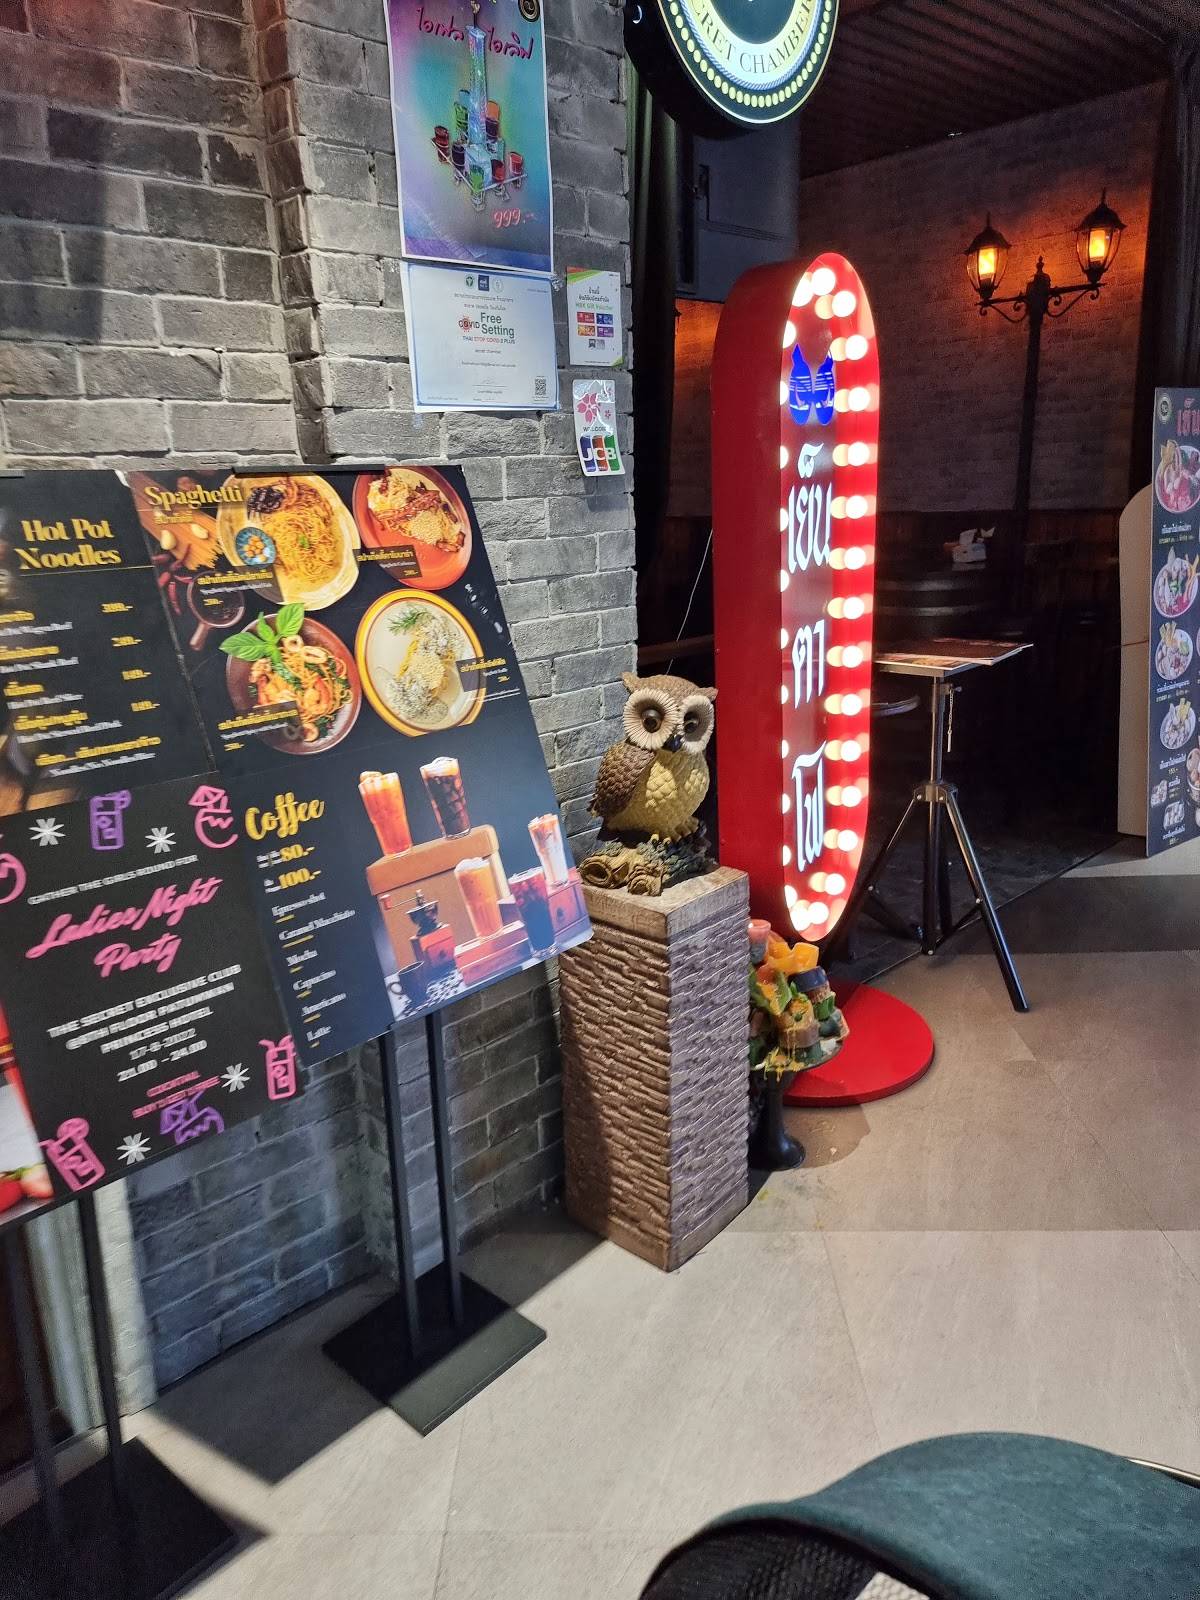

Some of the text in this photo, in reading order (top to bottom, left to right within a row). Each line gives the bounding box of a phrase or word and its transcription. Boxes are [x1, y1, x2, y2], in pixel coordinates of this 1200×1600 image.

[480, 312, 502, 323] Free
[481, 323, 515, 339] Setting
[144, 484, 243, 510] Spaghetti
[21, 518, 115, 541] Hot Pot
[14, 544, 122, 570] Noodles
[245, 792, 324, 840] Coffee
[79, 879, 102, 892] THE
[26, 877, 223, 959] Ladies Night
[94, 933, 182, 978] Party
[47, 1019, 80, 1038] THE
